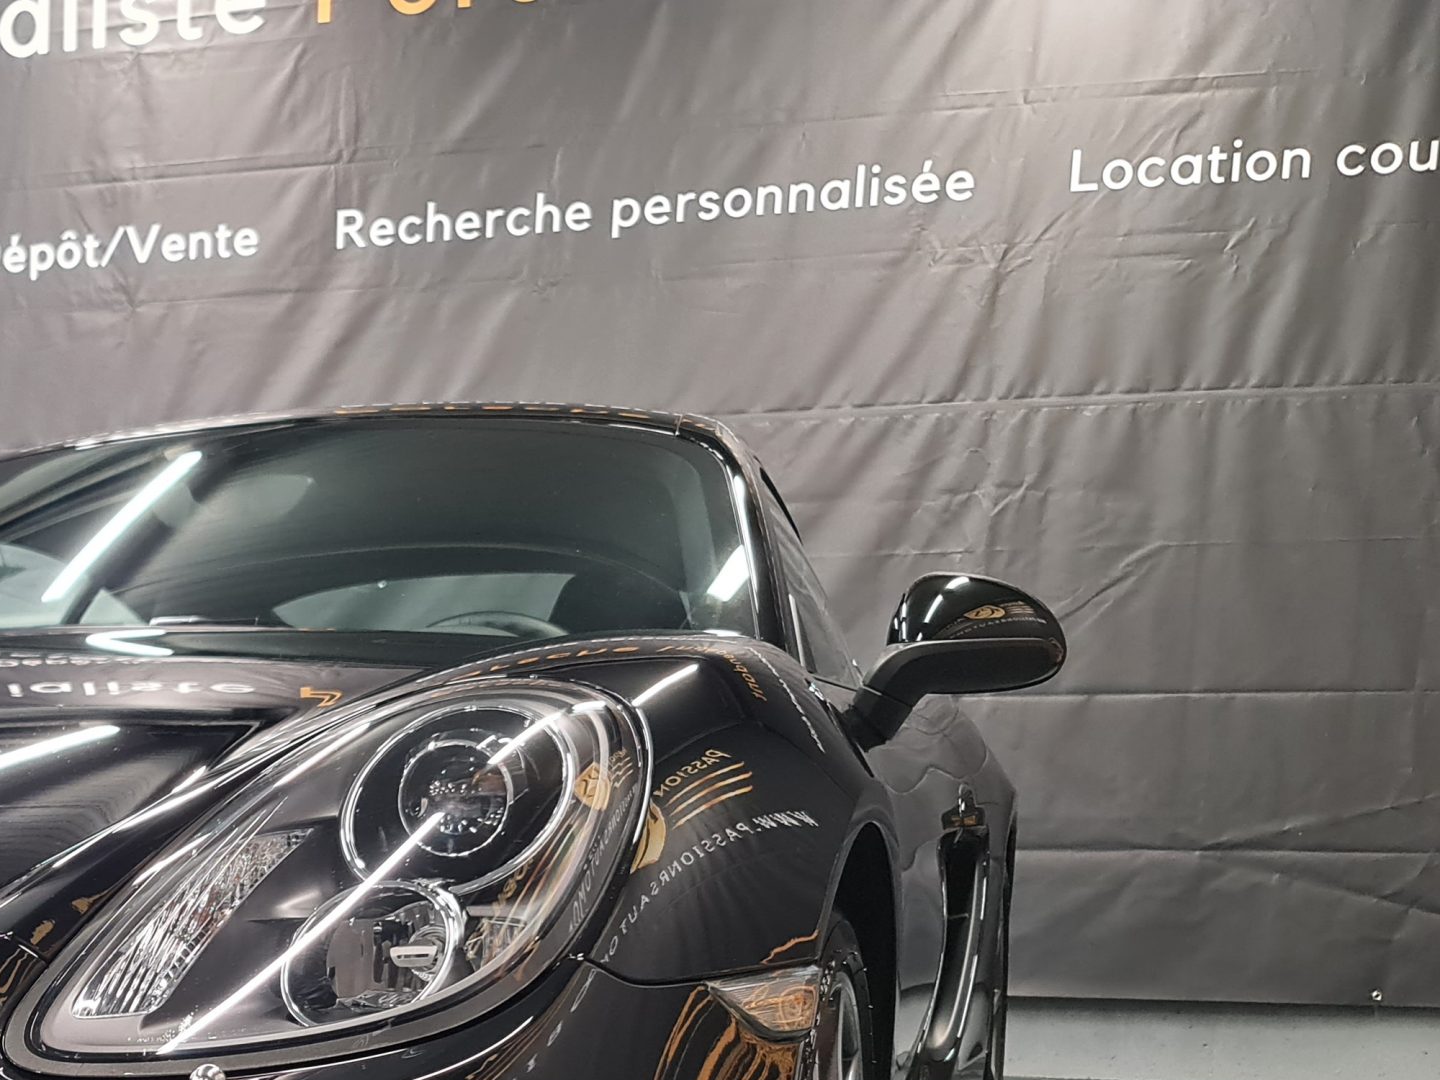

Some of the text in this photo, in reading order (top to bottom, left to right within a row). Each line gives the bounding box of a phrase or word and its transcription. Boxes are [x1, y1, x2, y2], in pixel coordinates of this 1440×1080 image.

[1069, 137, 1311, 193] Location
[334, 159, 976, 250] Recherche personnalisée
